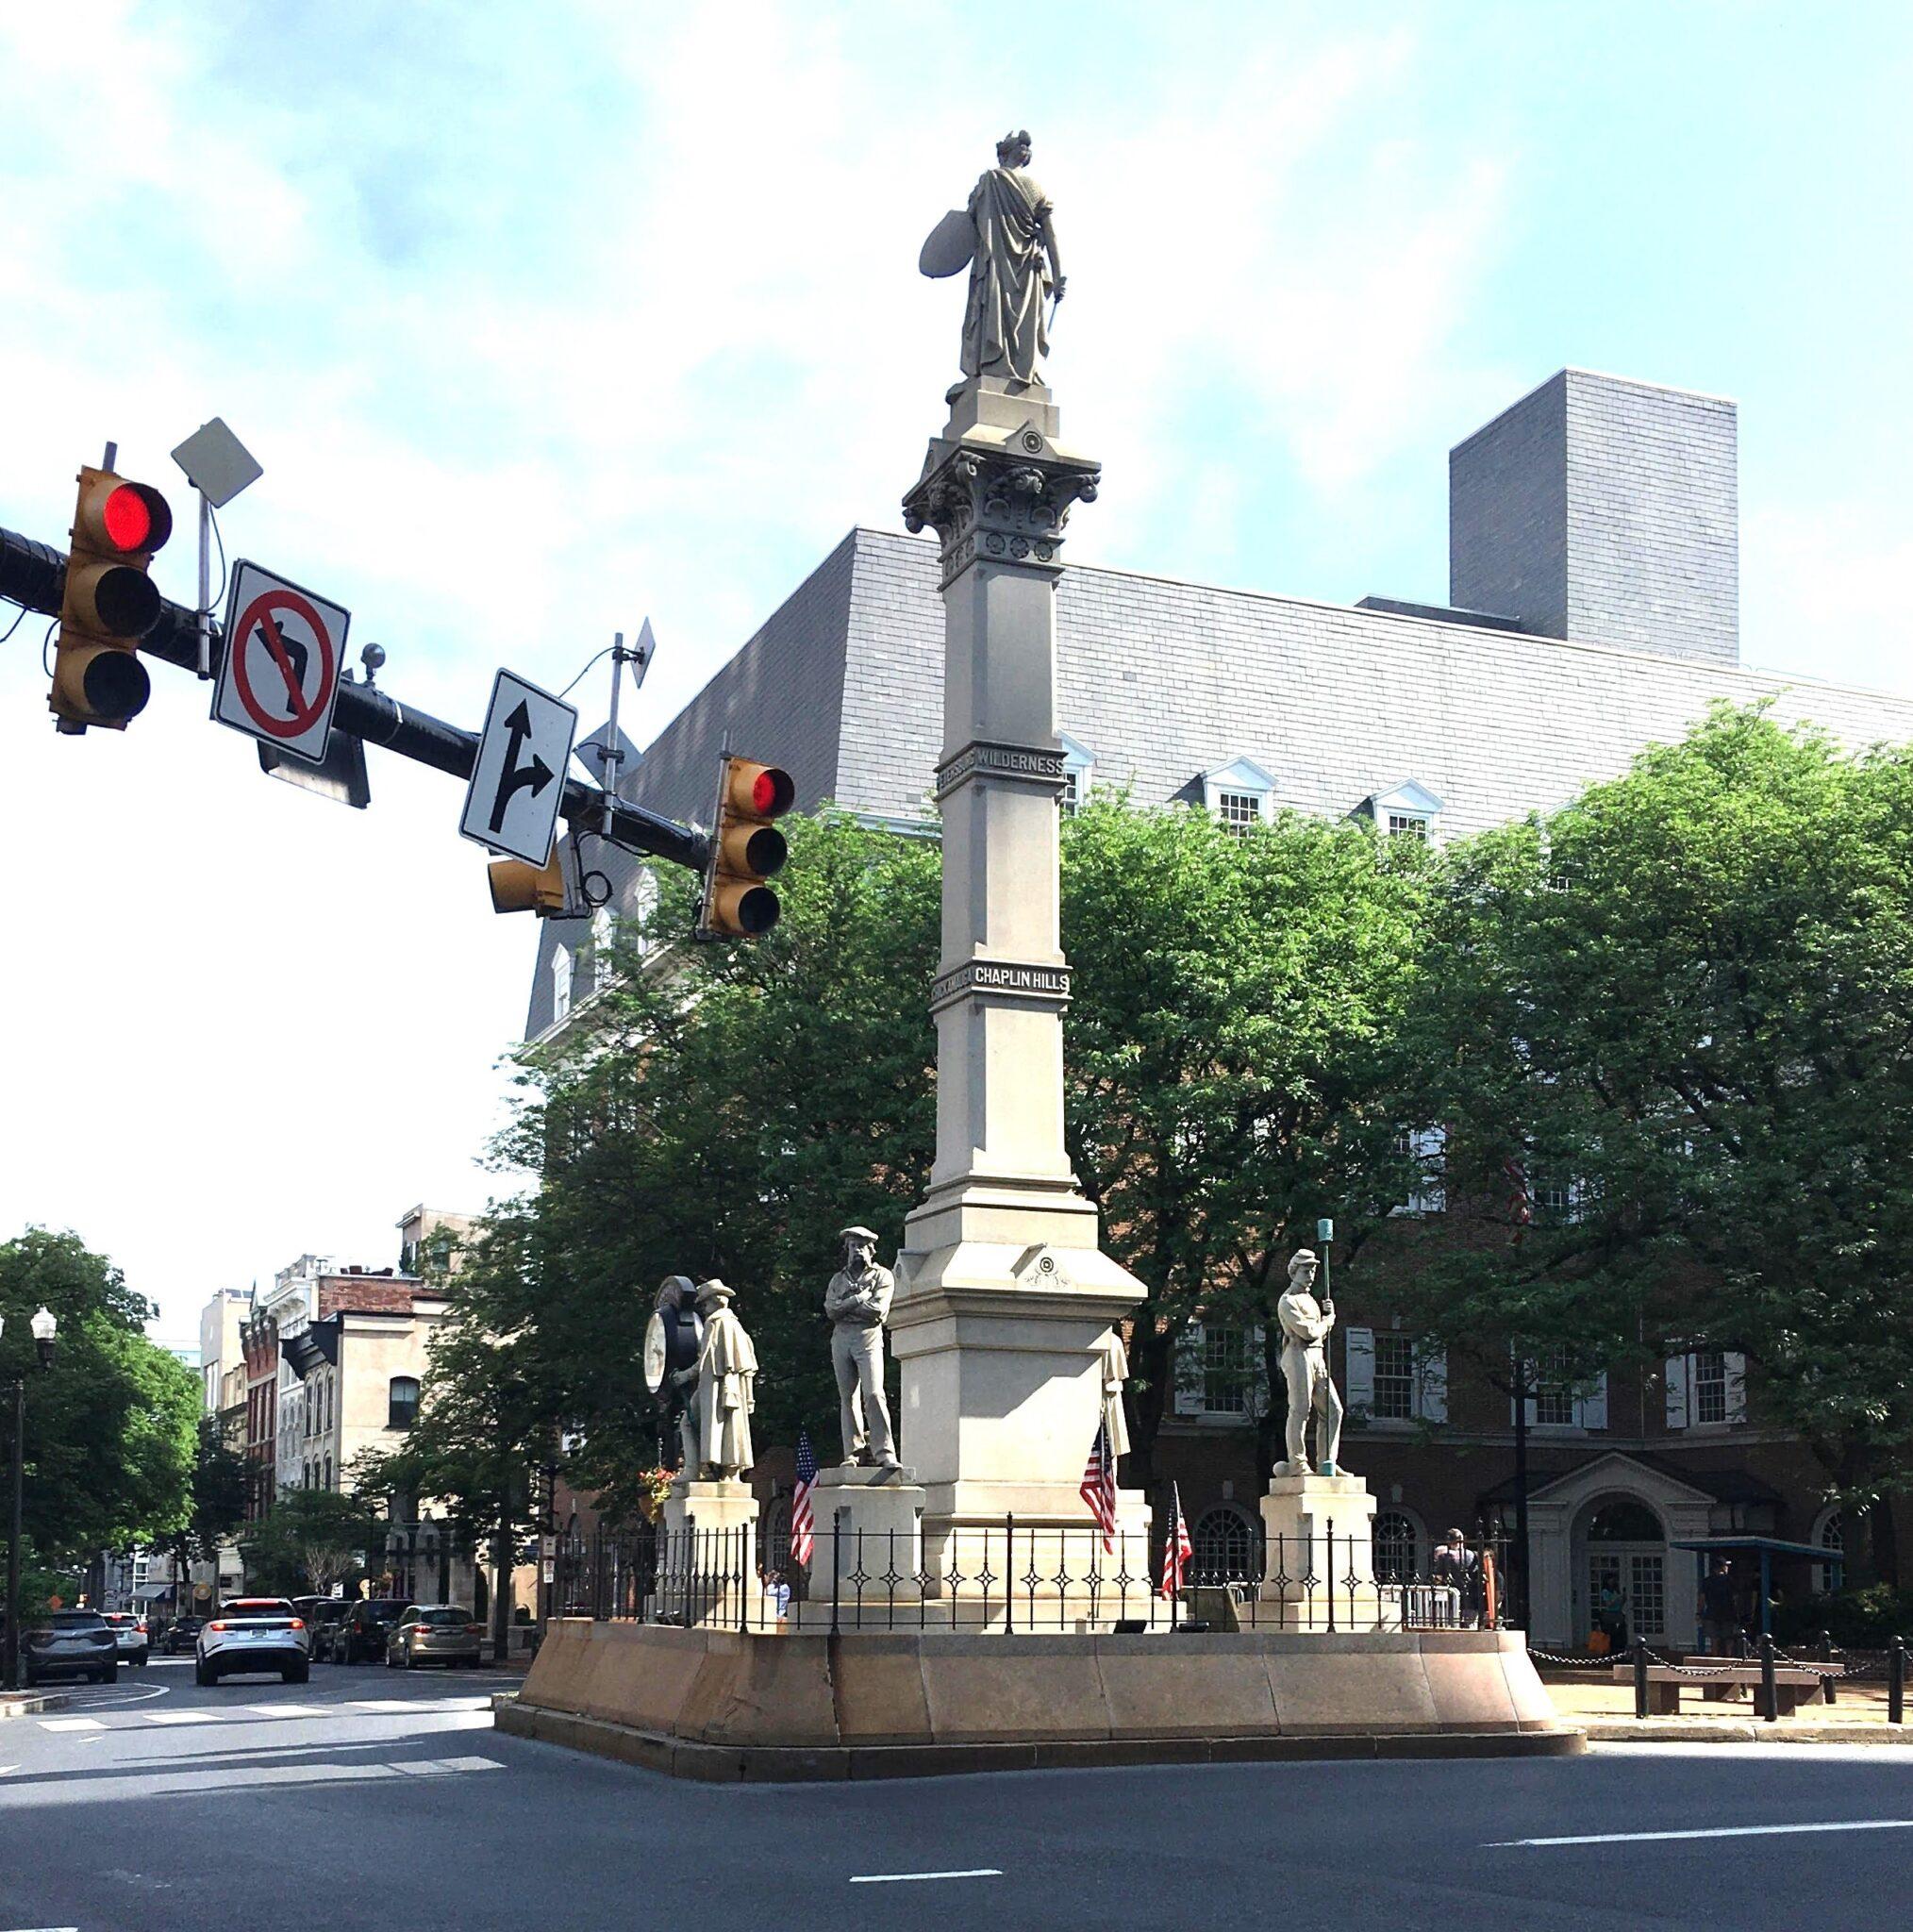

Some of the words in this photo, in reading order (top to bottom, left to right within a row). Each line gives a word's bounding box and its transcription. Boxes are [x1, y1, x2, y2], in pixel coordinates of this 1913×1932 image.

[977, 749, 1064, 774] WILDERNESS
[975, 967, 1030, 988] CHAPLIN
[1033, 973, 1071, 992] HILLS
